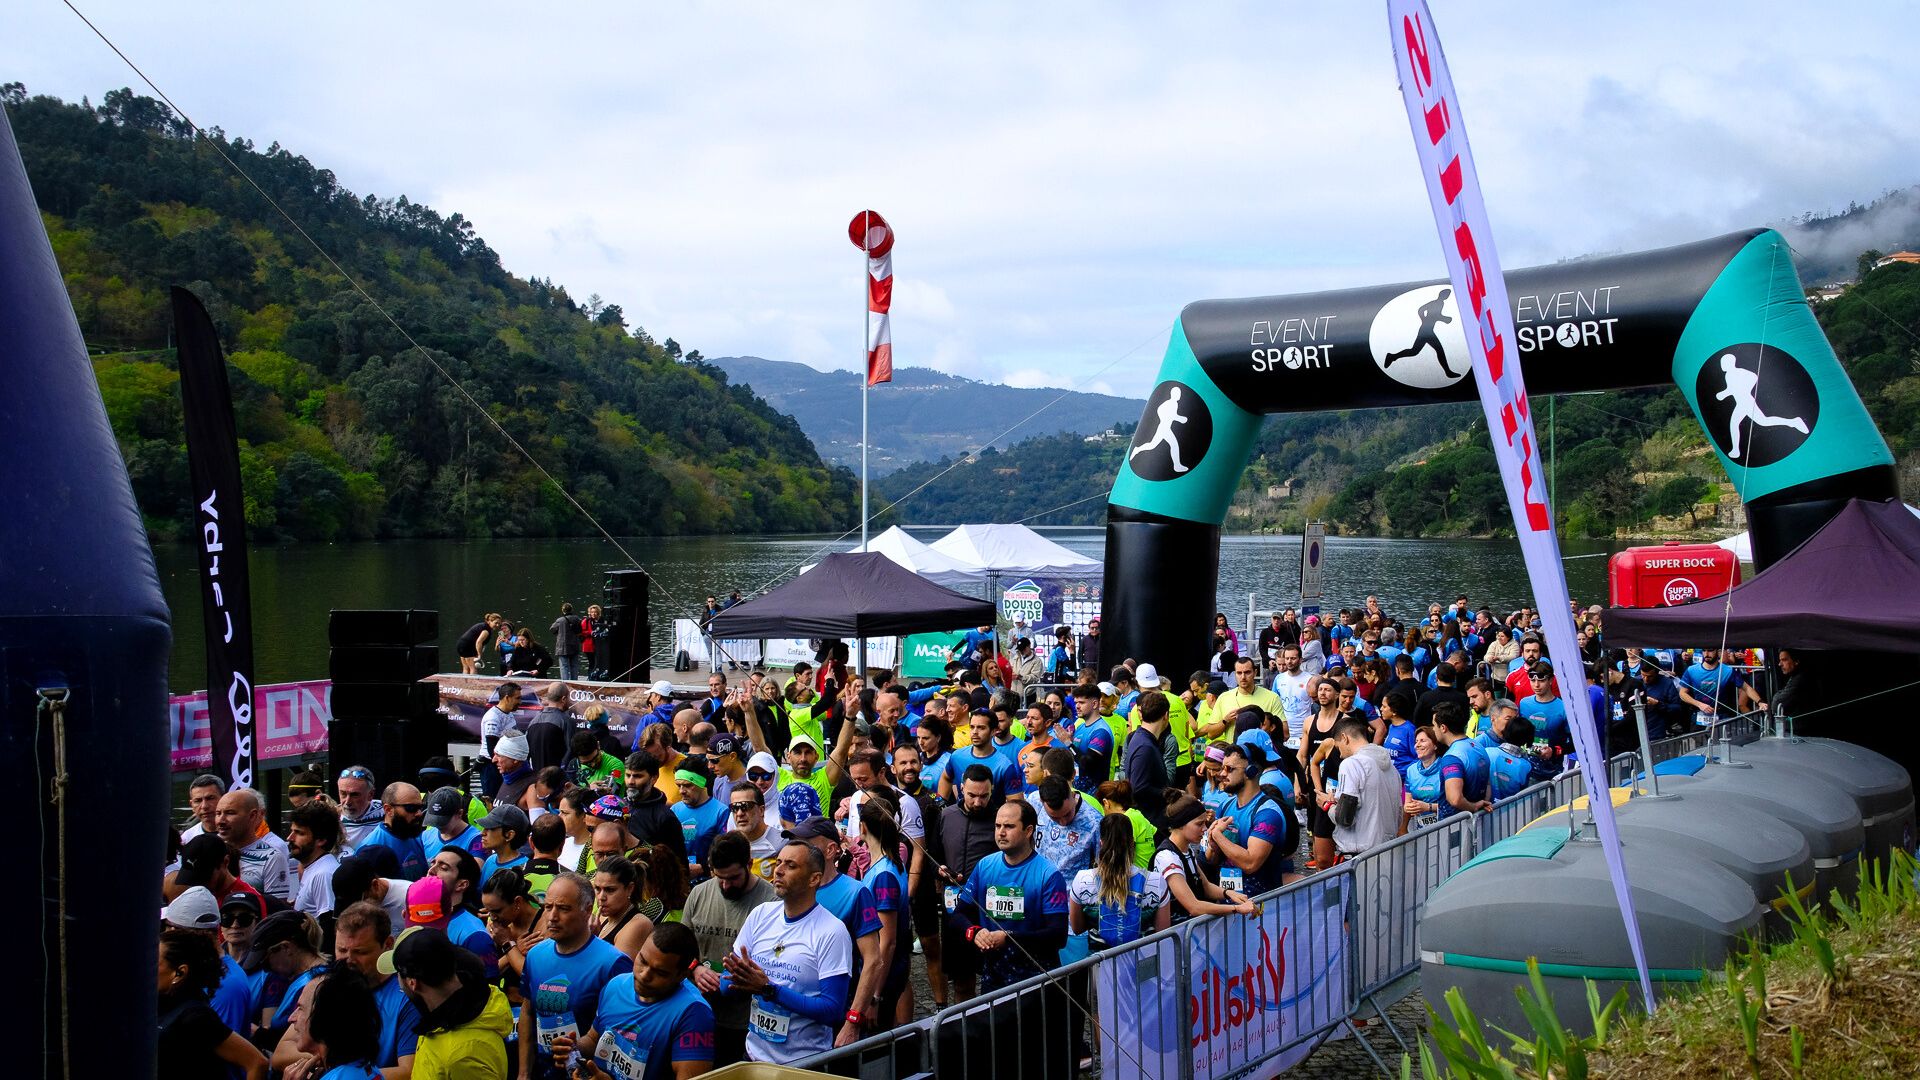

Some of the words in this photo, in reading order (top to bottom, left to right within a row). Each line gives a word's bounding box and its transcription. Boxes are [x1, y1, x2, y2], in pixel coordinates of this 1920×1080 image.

[1516, 286, 1620, 323] EVENT
[1250, 315, 1337, 345] EVENT
[1517, 318, 1619, 352] SPORT
[1251, 344, 1334, 372] SPORT
[1645, 559, 1680, 569] SUPER
[1683, 558, 1715, 568] BOCK
[1004, 600, 1042, 609] DOURO
[1005, 610, 1041, 620] VRDE
[599, 695, 625, 704] Carby
[264, 743, 292, 753] OCEAN
[294, 737, 329, 750] NETWORK
[1421, 816, 1439, 825] 1695
[996, 900, 1014, 912] 1076
[751, 954, 770, 965] ANDA
[771, 961, 802, 973] MARCIAL
[757, 1014, 778, 1032] 1842
[611, 1051, 632, 1076] 1456
